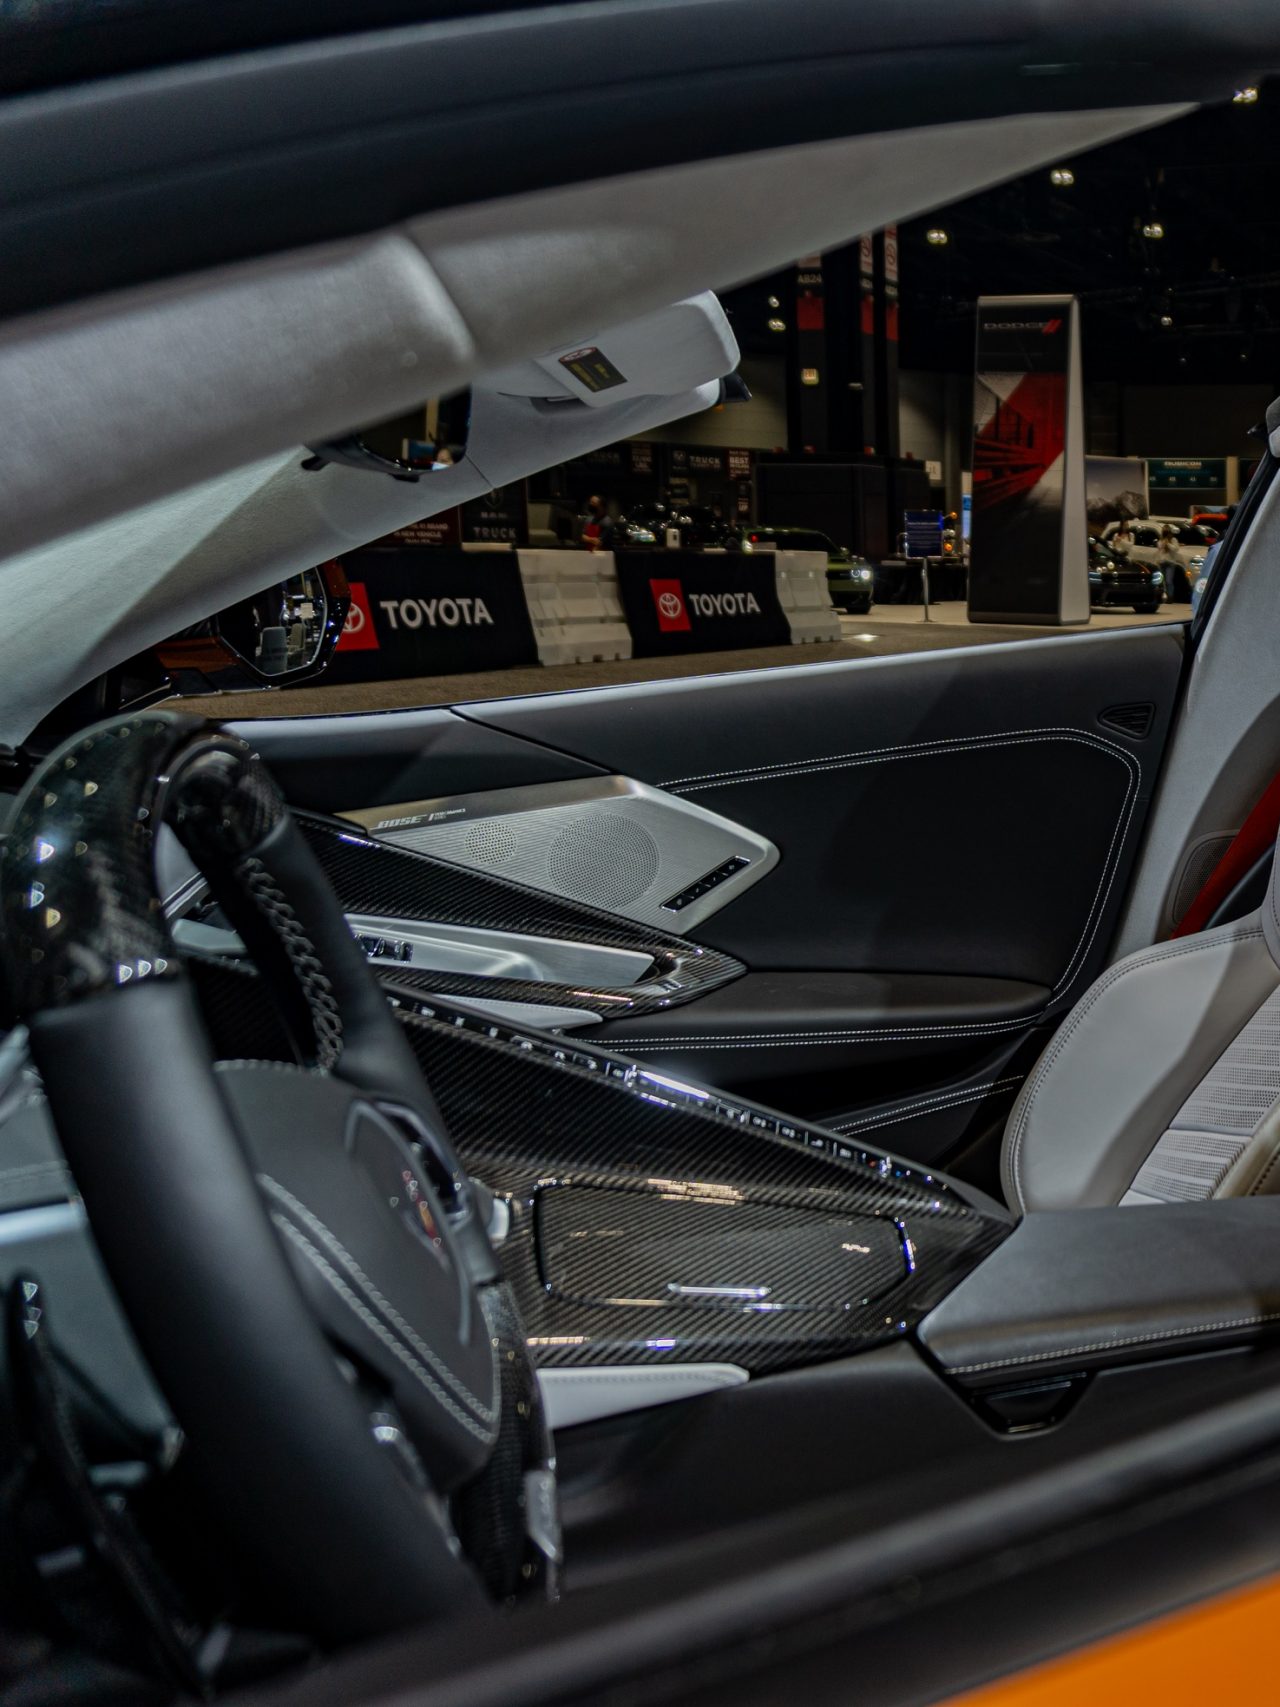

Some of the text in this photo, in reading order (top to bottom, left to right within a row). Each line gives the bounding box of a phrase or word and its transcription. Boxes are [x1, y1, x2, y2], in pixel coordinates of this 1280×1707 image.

[689, 455, 721, 465] TRUCK
[729, 456, 749, 464] BEST
[473, 526, 517, 539] TRUCK
[688, 592, 762, 616] TOYOTA
[380, 597, 494, 630] TOYOTA
[374, 814, 428, 830] BOSE
